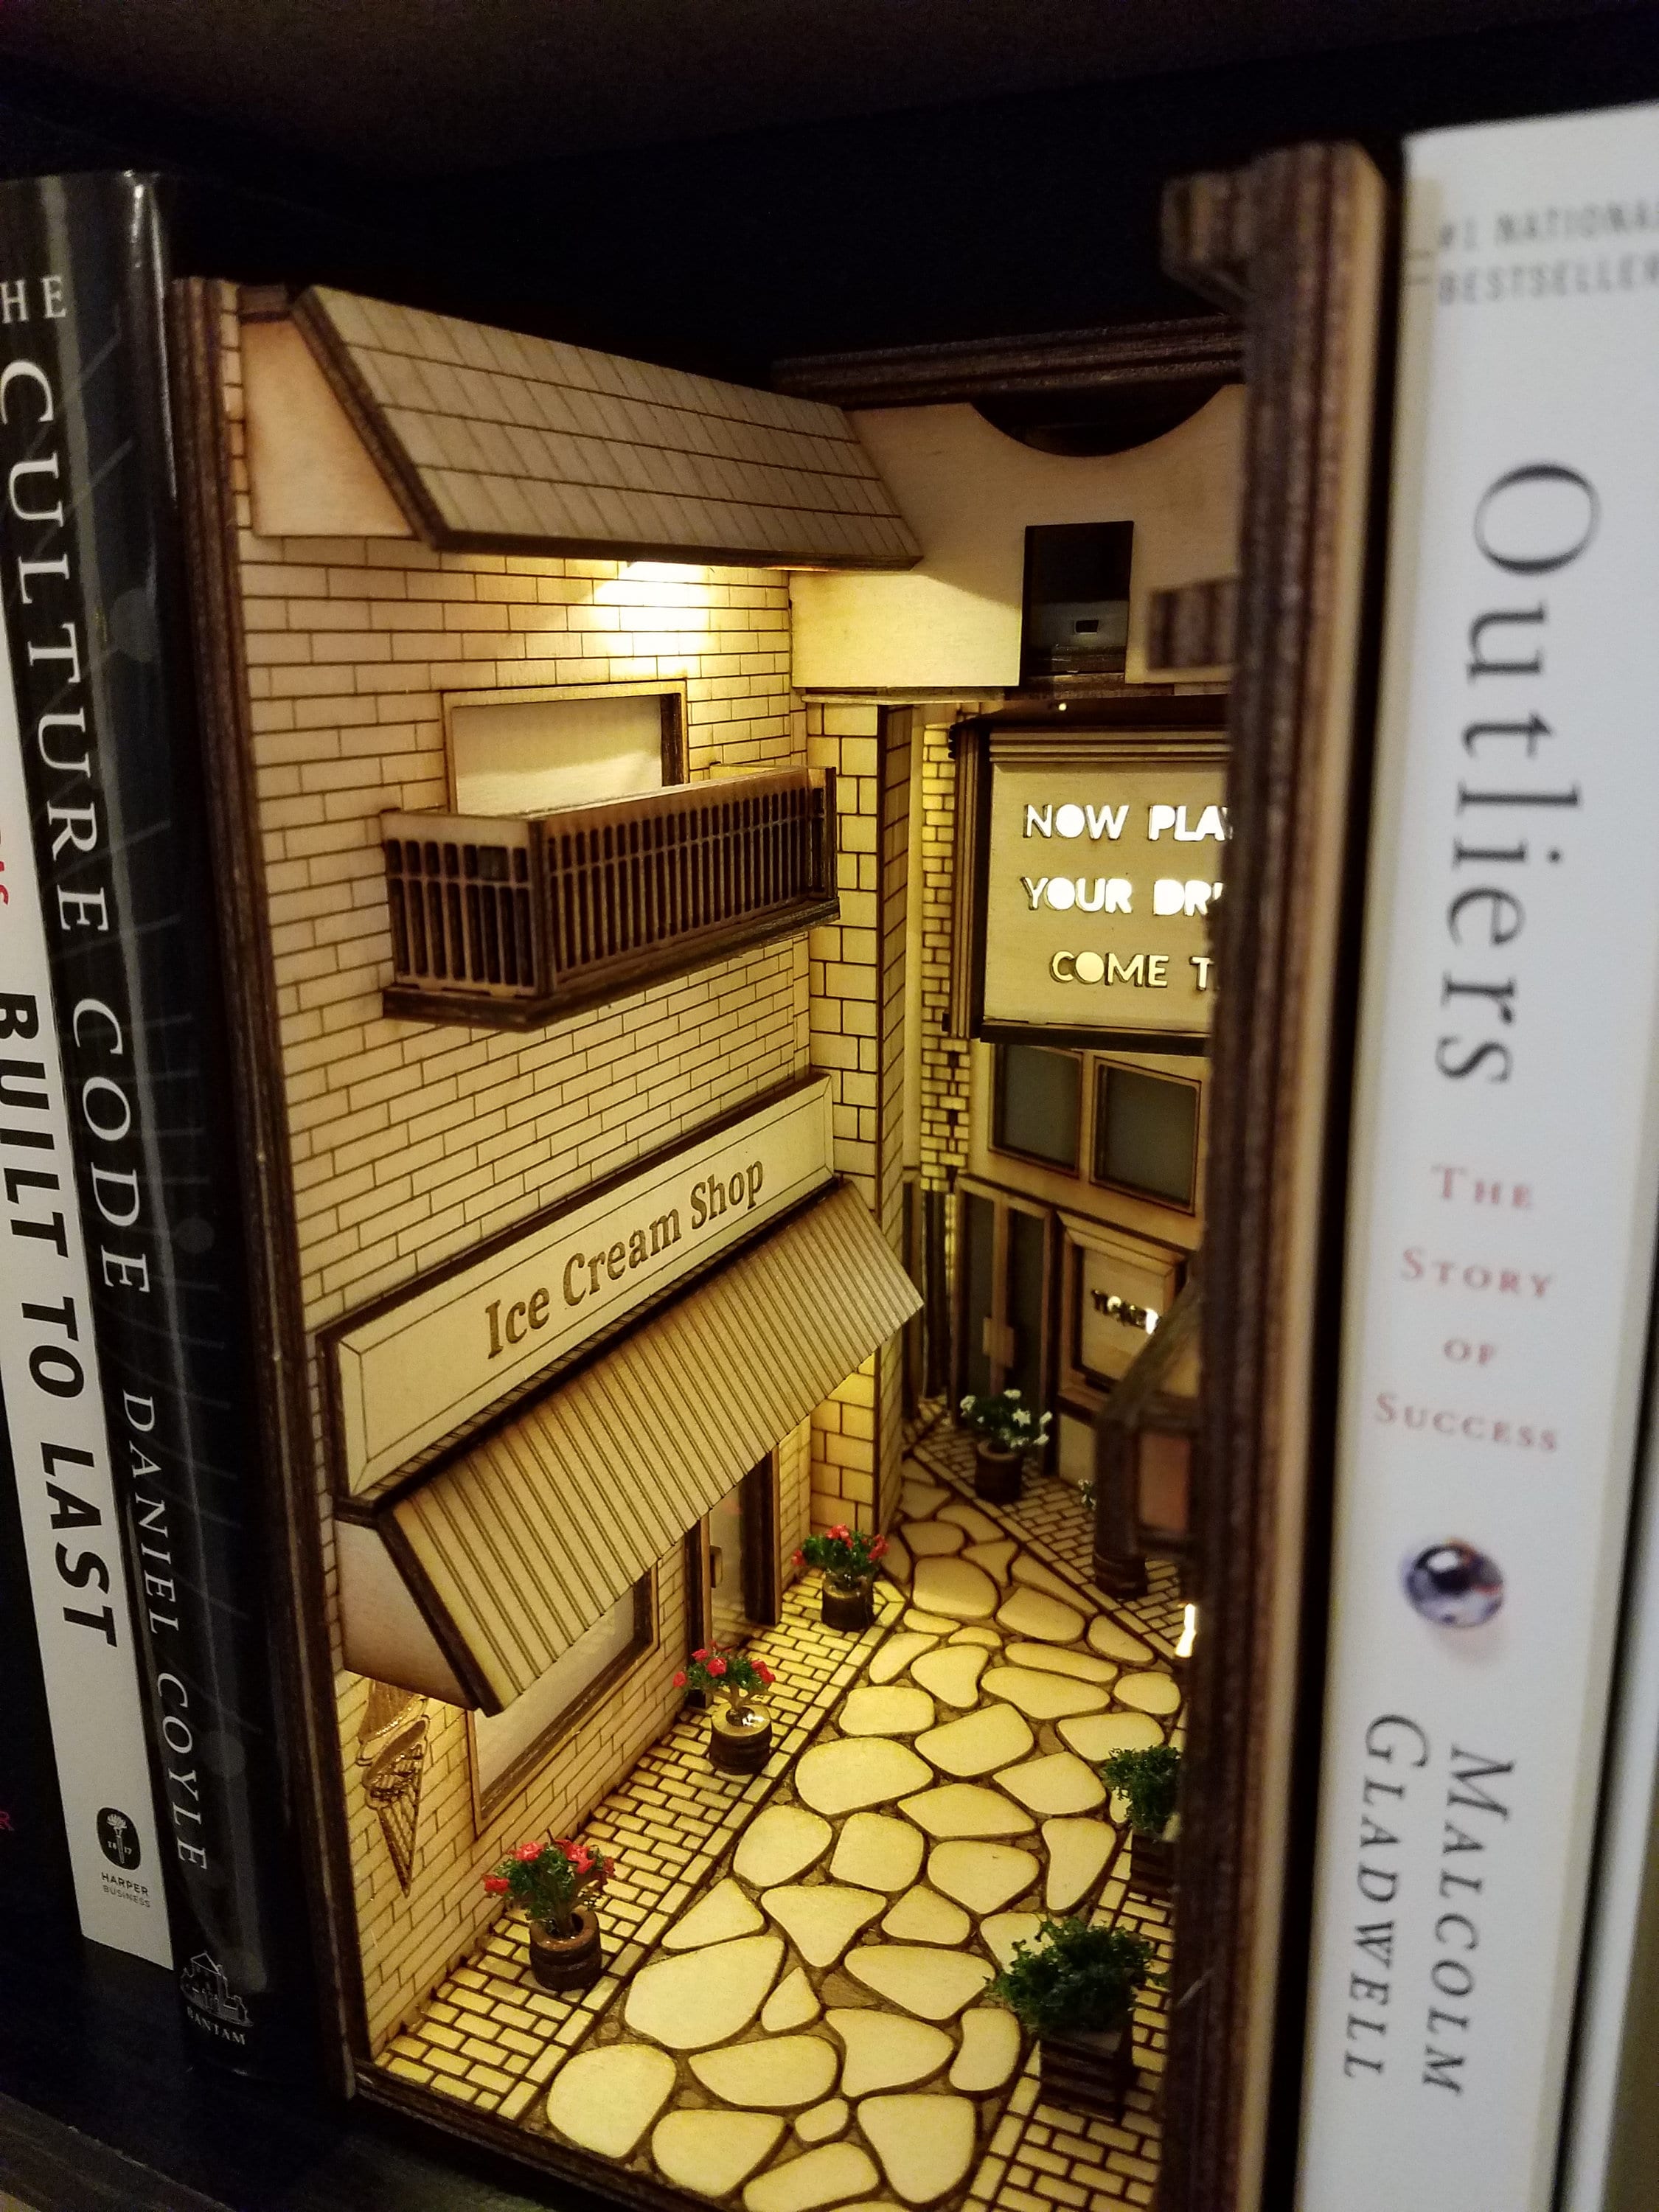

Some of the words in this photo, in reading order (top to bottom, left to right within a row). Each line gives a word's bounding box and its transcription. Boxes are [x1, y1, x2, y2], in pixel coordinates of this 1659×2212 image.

[1495, 198, 1659, 245] NATIONA
[1, 276, 67, 324] HE
[1, 360, 109, 932] CULTURE
[1435, 459, 1603, 1083] Outliers
[1023, 804, 1130, 841] NOW
[1020, 877, 1133, 914] YOUR
[1050, 950, 1169, 989] COME
[0, 992, 69, 1258] BUILT
[74, 998, 150, 1293] CODE
[1430, 1164, 1533, 1210] THE
[484, 1287, 551, 1360] Ice
[563, 1208, 682, 1306] Cream
[690, 1160, 764, 1230] Shop
[1400, 1245, 1553, 1298] STORY
[21, 1296, 85, 1398] TO
[1374, 1391, 1559, 1452] SUCCESS
[41, 1441, 117, 1647] LAST
[122, 1389, 179, 1633] DANIEL
[156, 1672, 207, 1870] COYLE
[100, 1871, 149, 1896] HARPER
[102, 1885, 150, 1908] BUSINESS
[1343, 1713, 1430, 2079] GLADWELL
[1422, 1742, 1517, 2097] MALCOLM
[187, 2006, 246, 2045] BANTAM
